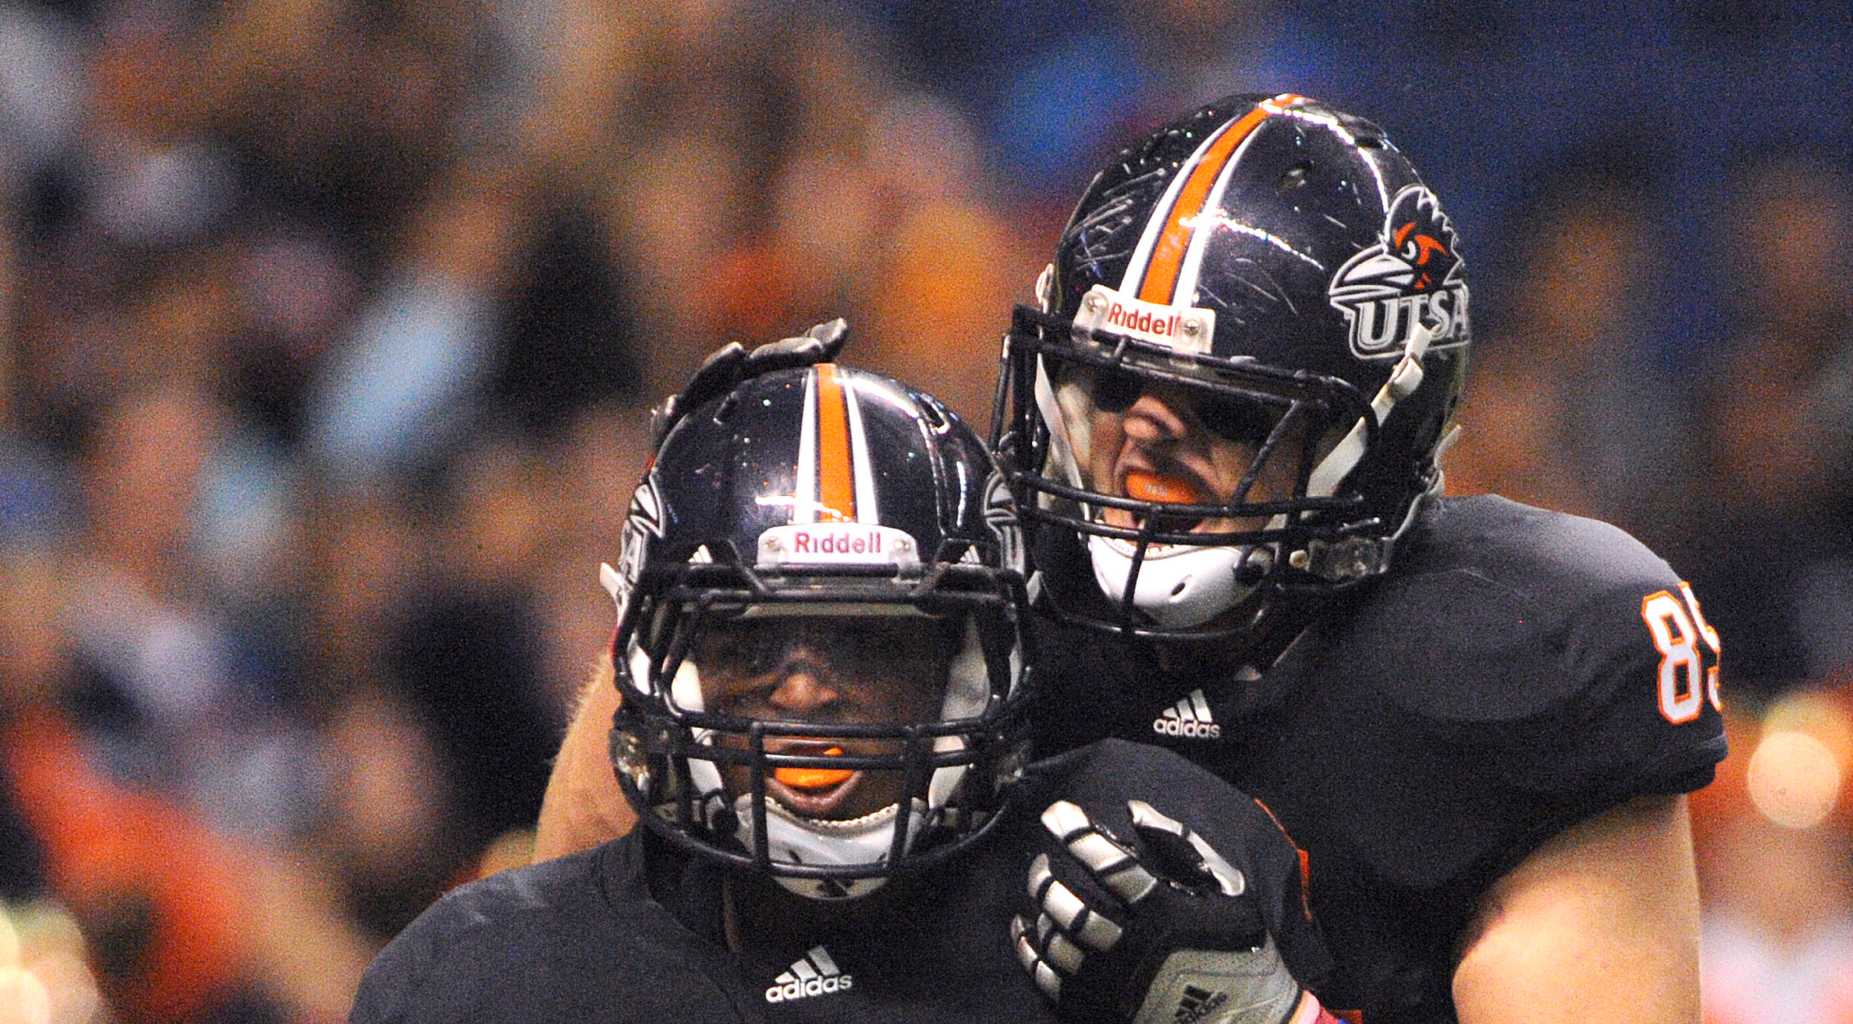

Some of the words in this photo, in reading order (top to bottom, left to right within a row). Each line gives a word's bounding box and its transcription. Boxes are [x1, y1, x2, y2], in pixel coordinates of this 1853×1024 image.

[1355, 287, 1469, 350] UTSA
[795, 532, 882, 554] Riddell
[1153, 716, 1221, 738] adidas
[765, 974, 853, 1003] adidas
